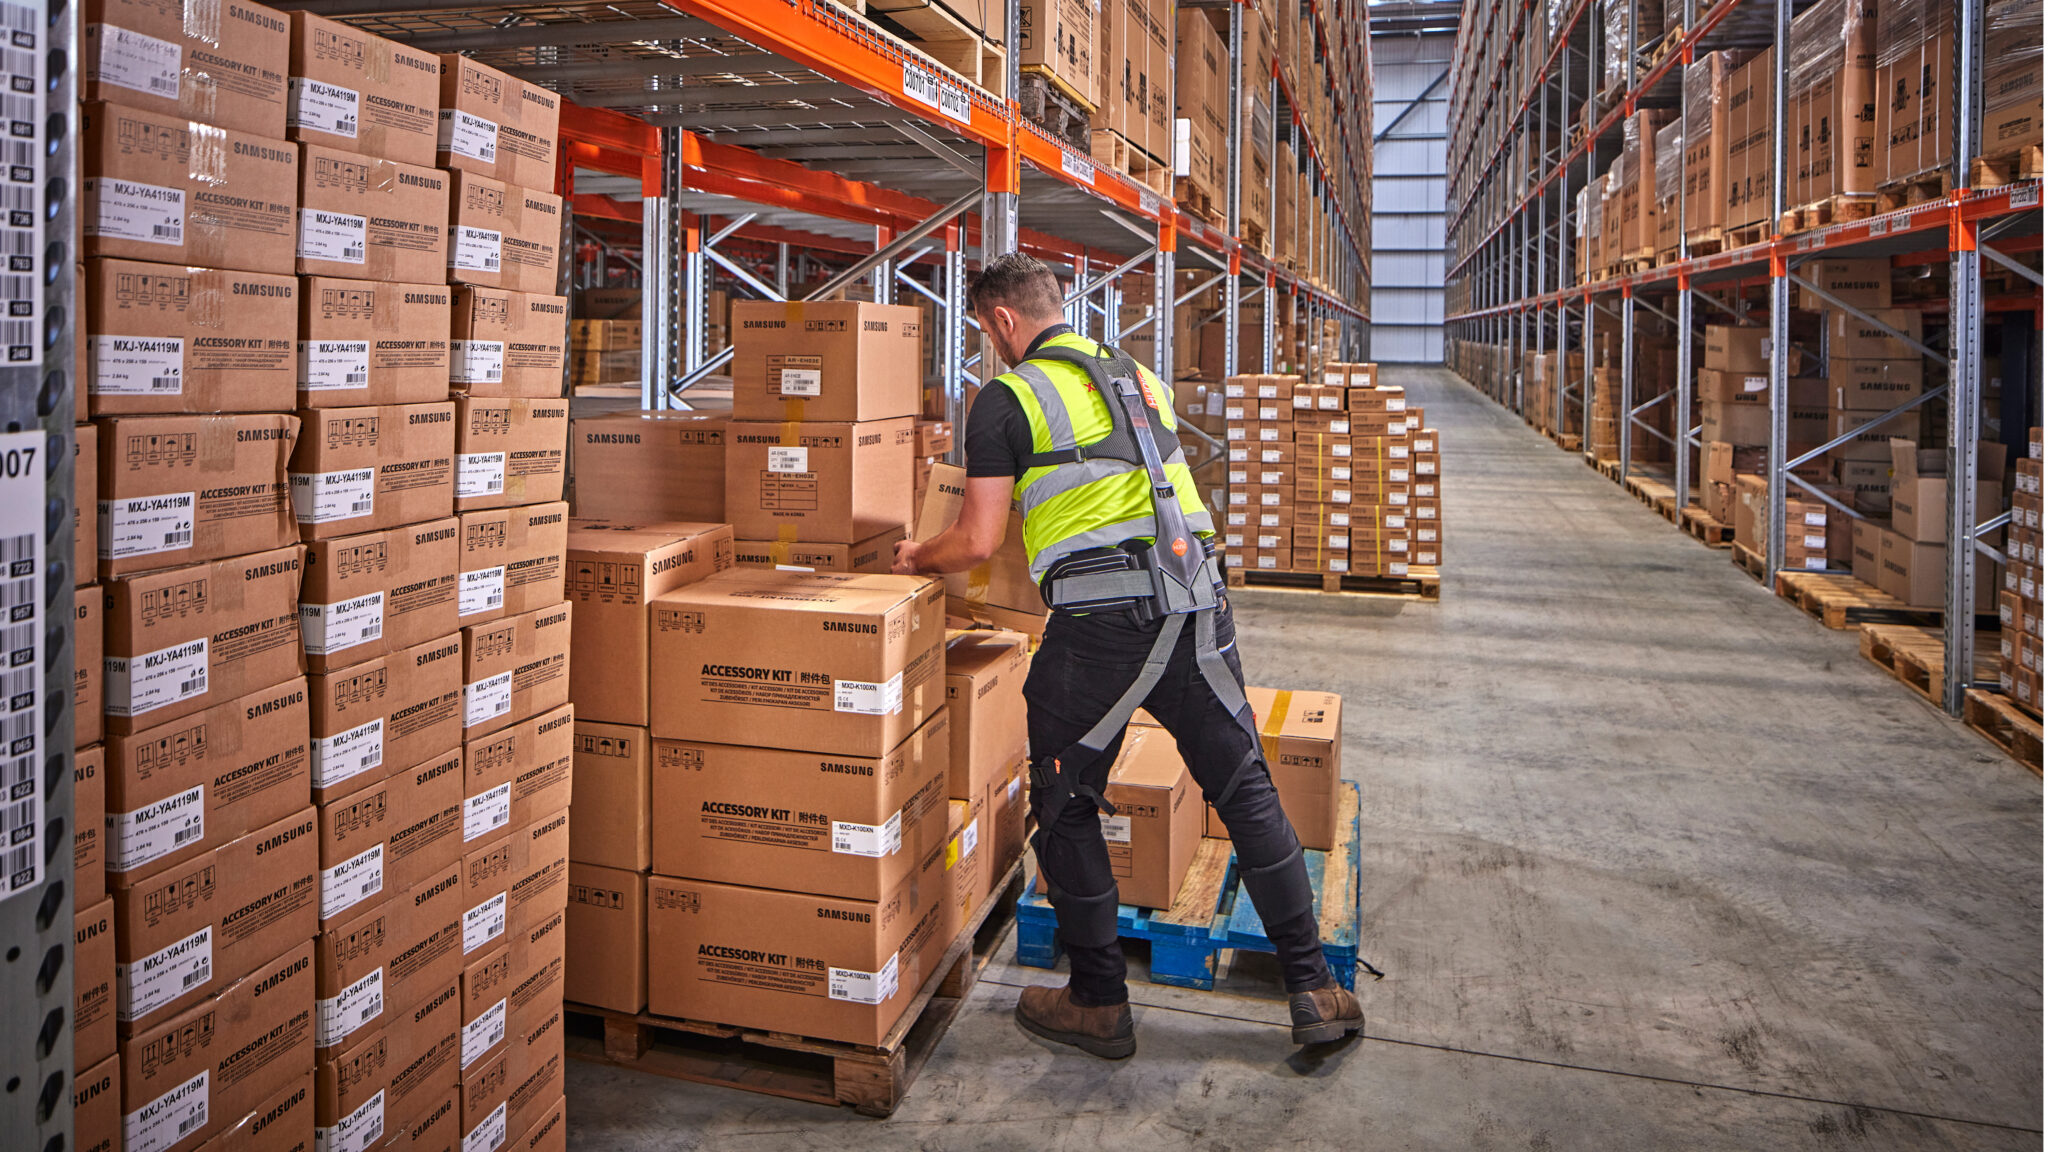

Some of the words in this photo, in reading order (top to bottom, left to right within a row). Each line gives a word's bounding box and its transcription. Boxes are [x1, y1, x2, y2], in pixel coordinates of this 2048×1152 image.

[230, 5, 285, 33] SAMSUNG
[190, 50, 241, 72] ACCESSORY
[243, 59, 257, 74] KIT
[395, 53, 437, 74] SAMSUNG
[310, 82, 357, 103] MXJ-YA4119M
[522, 89, 554, 109] SAMSUNG
[366, 94, 403, 112] ACCESSORY
[405, 103, 416, 113] KIT
[233, 142, 292, 164] SAMSUNG
[399, 173, 442, 190] SAMSUNG
[115, 183, 180, 203] MXJ-YA4119M
[195, 191, 249, 209] ACCESSORY
[249, 196, 264, 210] KIT
[525, 198, 556, 215] SAMSUNG
[316, 212, 363, 229] MXJ-YA4119M
[370, 216, 408, 229] ACCESSORY
[409, 221, 420, 231] KIT
[233, 282, 292, 298] SAMSUNG
[405, 293, 447, 305] SAMSUNG
[531, 302, 563, 314] SAMSUNG
[864, 320, 888, 332] SAMSUNG
[1859, 329, 1910, 337] SAMSG
[114, 340, 180, 353] MXJ-YA4119M
[193, 338, 246, 348] ACCESSORY
[248, 340, 262, 349] KIT
[319, 343, 366, 353] MXJ-YA4119M
[376, 340, 413, 349] ACCESSORY
[415, 341, 426, 349] KIT
[1860, 382, 1911, 391] SAMSUNG
[409, 412, 451, 424] SAMSUNG
[532, 409, 564, 418] SAMSUNG
[1793, 412, 1829, 420] SAMSU
[237, 428, 290, 443] SAMSUNG
[587, 433, 641, 444] SAMSUNG
[737, 435, 780, 444] SAMSUNG
[858, 434, 881, 446] SAMSUNG
[381, 462, 418, 474] ACCESSORY
[420, 460, 430, 468] KIT
[326, 471, 371, 485] MXJ-YA4119M
[200, 486, 250, 500] ACCESSORY
[252, 484, 266, 494] KIT
[939, 484, 965, 497] SAMS
[1857, 484, 1889, 493] SAMS
[128, 496, 190, 514] MXJ-YA4119M
[529, 513, 561, 526] SAMSUNG
[415, 527, 455, 545] SAMSUNG
[245, 559, 298, 581] SAMSUNG
[652, 550, 693, 575] SAMSUNG
[336, 595, 381, 614] MXJ-YA4119M
[535, 612, 566, 629] SAMSUNG
[823, 621, 878, 634] SAMSUNG
[213, 622, 260, 644] ACCESSORY
[261, 618, 274, 631] KIT
[145, 642, 204, 669] MXJ-YA4119M
[416, 643, 458, 666] SAMSUNG
[701, 664, 770, 680] ACCESSORY
[772, 669, 792, 682] KIT
[800, 672, 831, 685] 附件包
[978, 675, 998, 700] SAMSUNG
[247, 691, 303, 720] SAMSUNG
[390, 701, 427, 723] ACCESSORY
[428, 697, 439, 708] KIT
[538, 714, 571, 735] SAMSUNG
[333, 722, 380, 748] MXJ-YA4119M
[214, 760, 264, 788] ACCESSORY
[266, 754, 280, 768] KIT
[416, 758, 459, 785] SAMSUNG
[820, 762, 874, 776] SAMSUNG
[135, 790, 199, 825] MXJ-YA4119M
[701, 801, 769, 818] ACCESSORY
[770, 809, 790, 821] KIT
[798, 812, 828, 825] 附件包
[256, 821, 313, 855] SAMSUNG
[533, 816, 566, 840] SAMSUNG
[334, 848, 380, 878] MXJ-YA4119M
[415, 874, 458, 907] SAMSUNG
[222, 894, 273, 927] ACCESSORY
[274, 886, 287, 903] KIT
[817, 908, 871, 923] SAMSUNG
[531, 914, 562, 943] SAMSUNG
[144, 931, 207, 972] MXJ-YA4119M
[389, 938, 428, 969] ACCESSORY
[429, 931, 439, 945] KIT
[698, 944, 766, 962] ACCESSORY
[767, 952, 787, 966] KIT
[795, 956, 825, 970] 附件包
[254, 956, 309, 997] SAMSUNG
[414, 986, 456, 1023] SAMSUNG
[528, 1013, 559, 1045] SAMSUNG
[218, 1035, 268, 1073] ACCESSORY
[269, 1025, 284, 1043] KIT
[139, 1077, 204, 1123] MXJ-YA4119M
[252, 1088, 305, 1135] SAMSUNG
[412, 1099, 452, 1141] SAMSUNG
[529, 1111, 560, 1149] SAMSUNG
